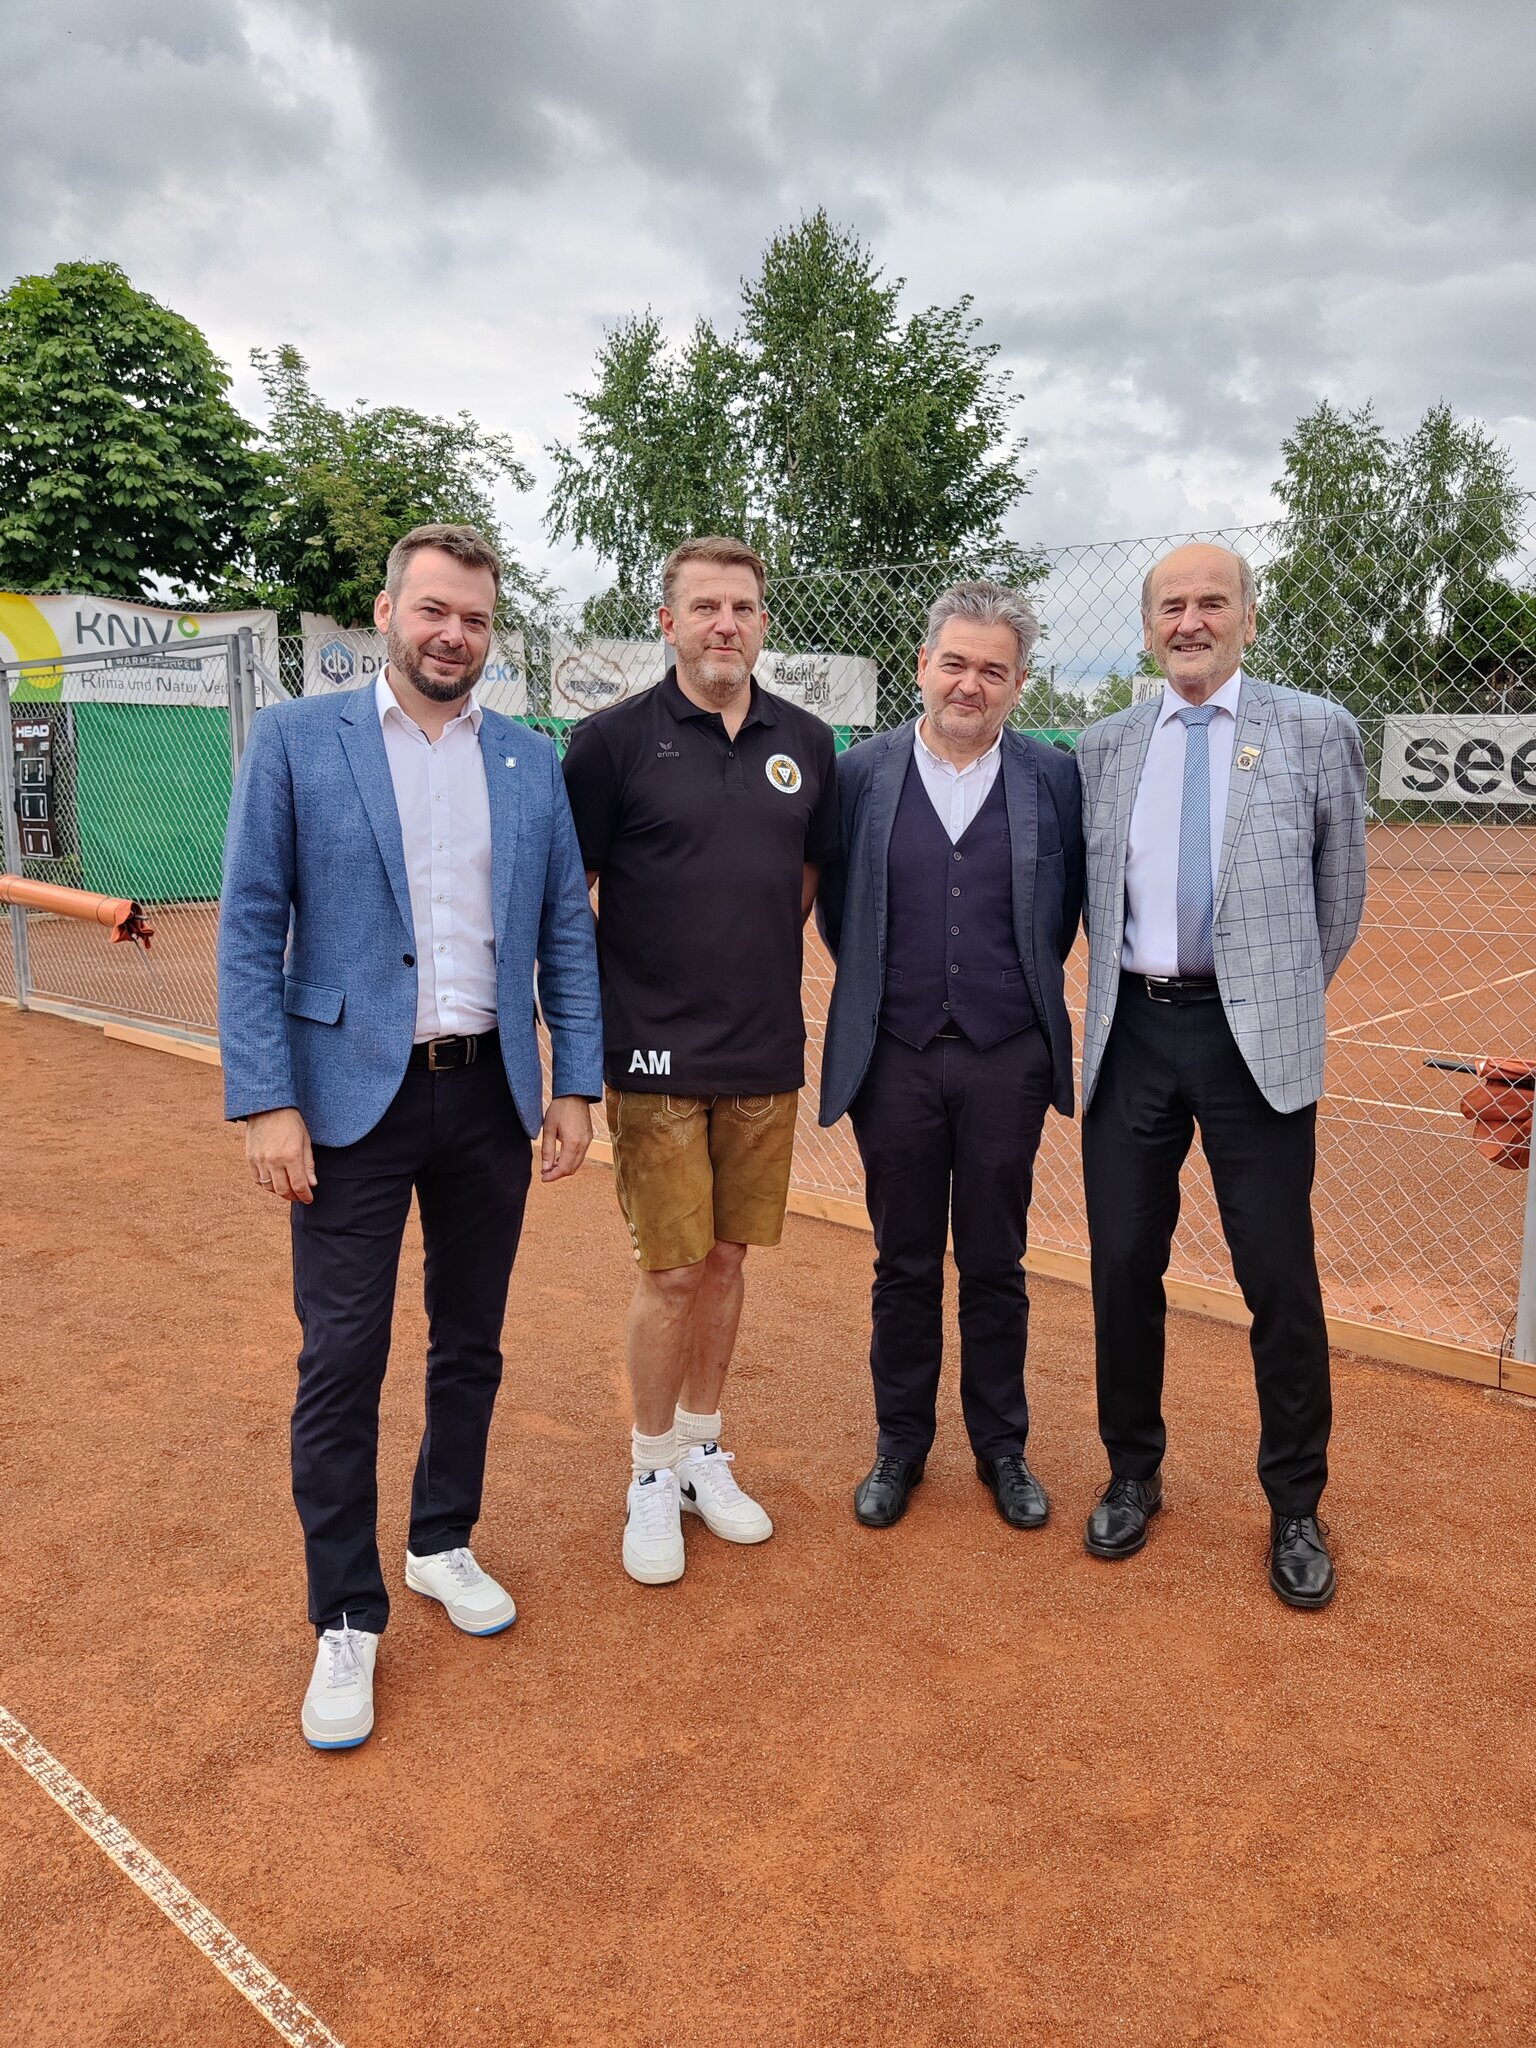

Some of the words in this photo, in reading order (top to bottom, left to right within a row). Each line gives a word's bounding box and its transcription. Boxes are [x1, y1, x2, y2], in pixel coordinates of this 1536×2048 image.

[76, 612, 173, 647] KNV
[81, 674, 124, 689] Klima
[157, 677, 198, 693] Natur
[15, 725, 50, 738] HEAD
[628, 1049, 671, 1075] AM
